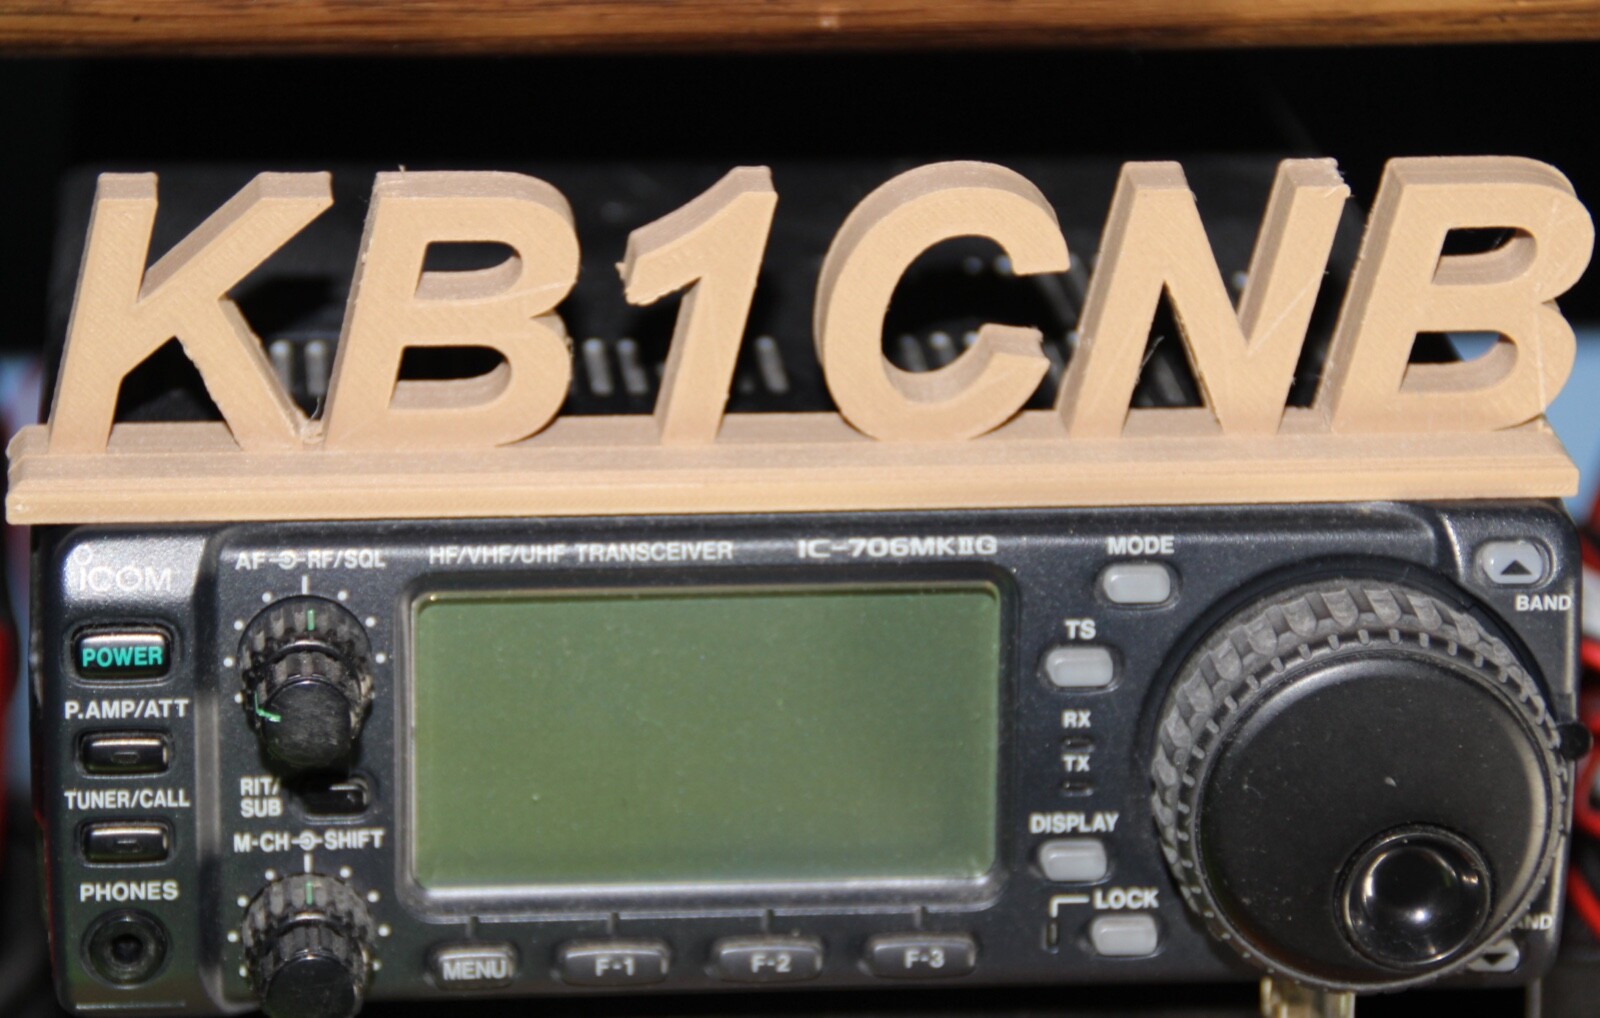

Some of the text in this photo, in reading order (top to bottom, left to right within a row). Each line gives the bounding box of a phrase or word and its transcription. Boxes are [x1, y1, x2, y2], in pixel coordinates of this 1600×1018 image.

[48, 155, 1595, 450] KB1CNB
[429, 541, 735, 565] HF/VHF/UHF TRANSCEIVER
[1106, 535, 1175, 556] MODE
[235, 550, 387, 570] AF RF/SQL
[1515, 594, 1573, 612] BAND
[1064, 619, 1097, 640] TS
[81, 646, 165, 668] POWER
[64, 698, 190, 720] P.AMP/ATT
[1061, 710, 1091, 729] RX
[1062, 755, 1091, 772] TX
[64, 788, 190, 810] TUNER/CALL
[239, 799, 283, 818] SUB
[1029, 812, 1120, 834] DISPLAY
[324, 828, 387, 850] SHIFT
[79, 882, 179, 903] PHONES
[1093, 889, 1160, 910] LOCK
[595, 957, 636, 977] F-1
[750, 954, 792, 974] F-2
[904, 948, 946, 970] F-3
[442, 961, 508, 982] MENU
